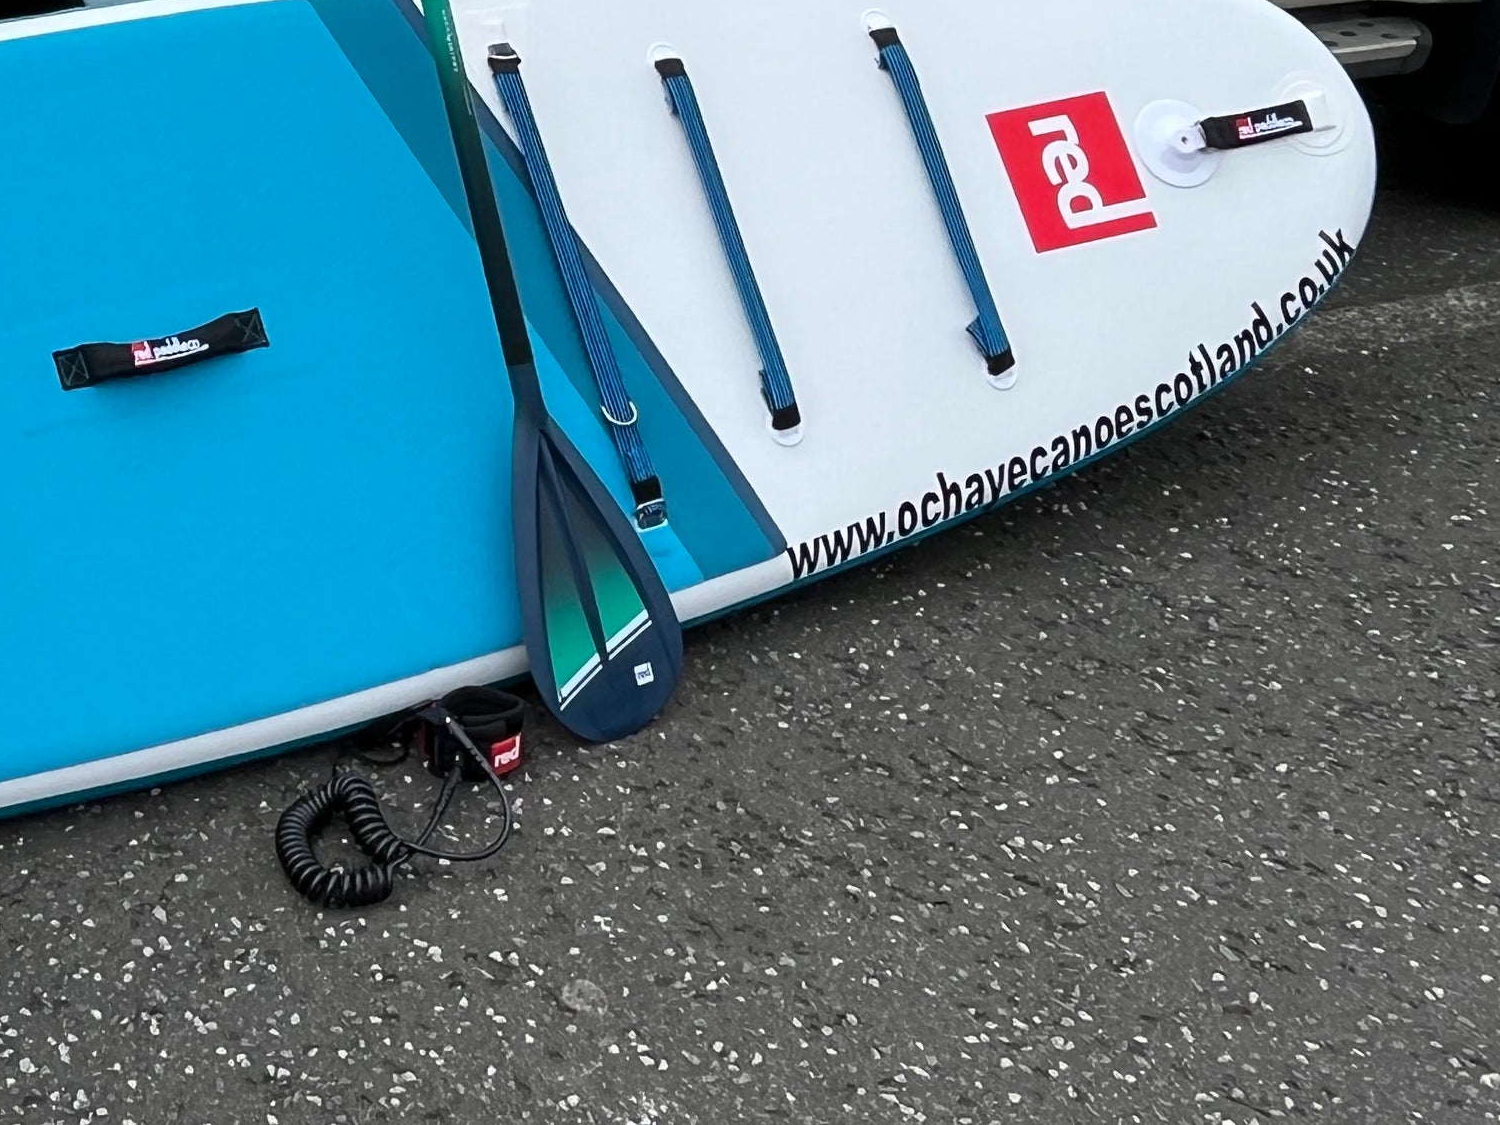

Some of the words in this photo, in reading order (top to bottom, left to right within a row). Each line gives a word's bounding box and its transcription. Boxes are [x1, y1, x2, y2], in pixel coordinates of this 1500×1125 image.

[1027, 114, 1149, 231] red
[786, 227, 1357, 577] www.ochayecanoescotland.co.uk
[494, 733, 522, 768] red
